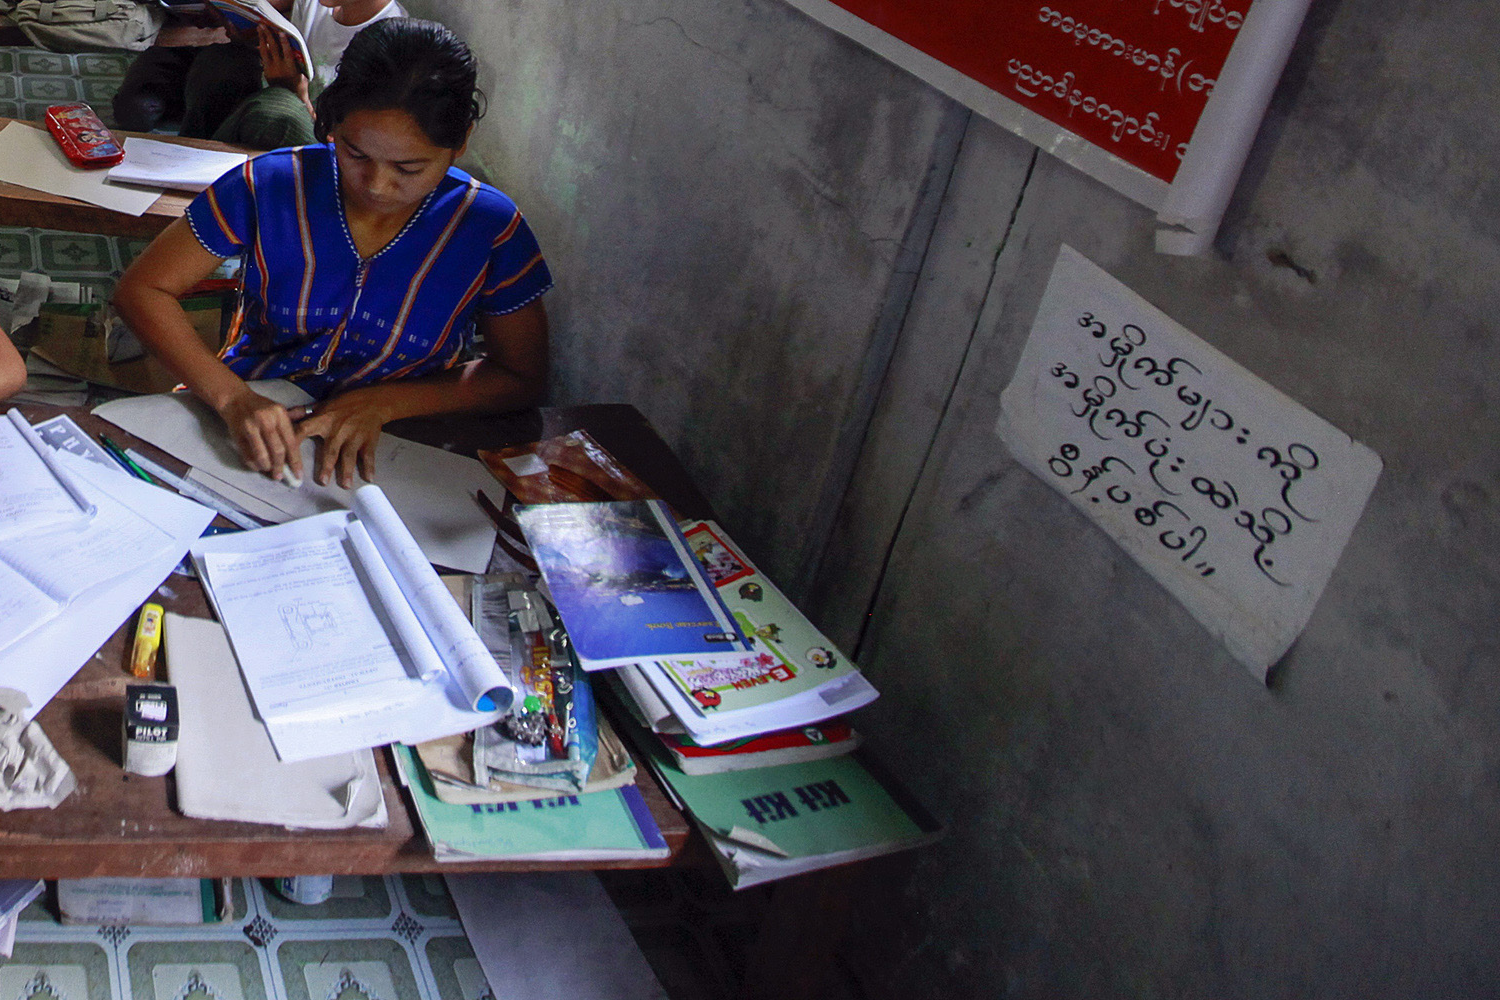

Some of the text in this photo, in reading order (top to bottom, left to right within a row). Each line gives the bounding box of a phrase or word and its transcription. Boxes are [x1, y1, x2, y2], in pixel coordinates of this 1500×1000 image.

[1051, 362, 1293, 587] အမှိုက်ပုံးထဲသို့
[1078, 311, 1320, 523] အမှိုက်များကို
[136, 726, 168, 738] PILOT
